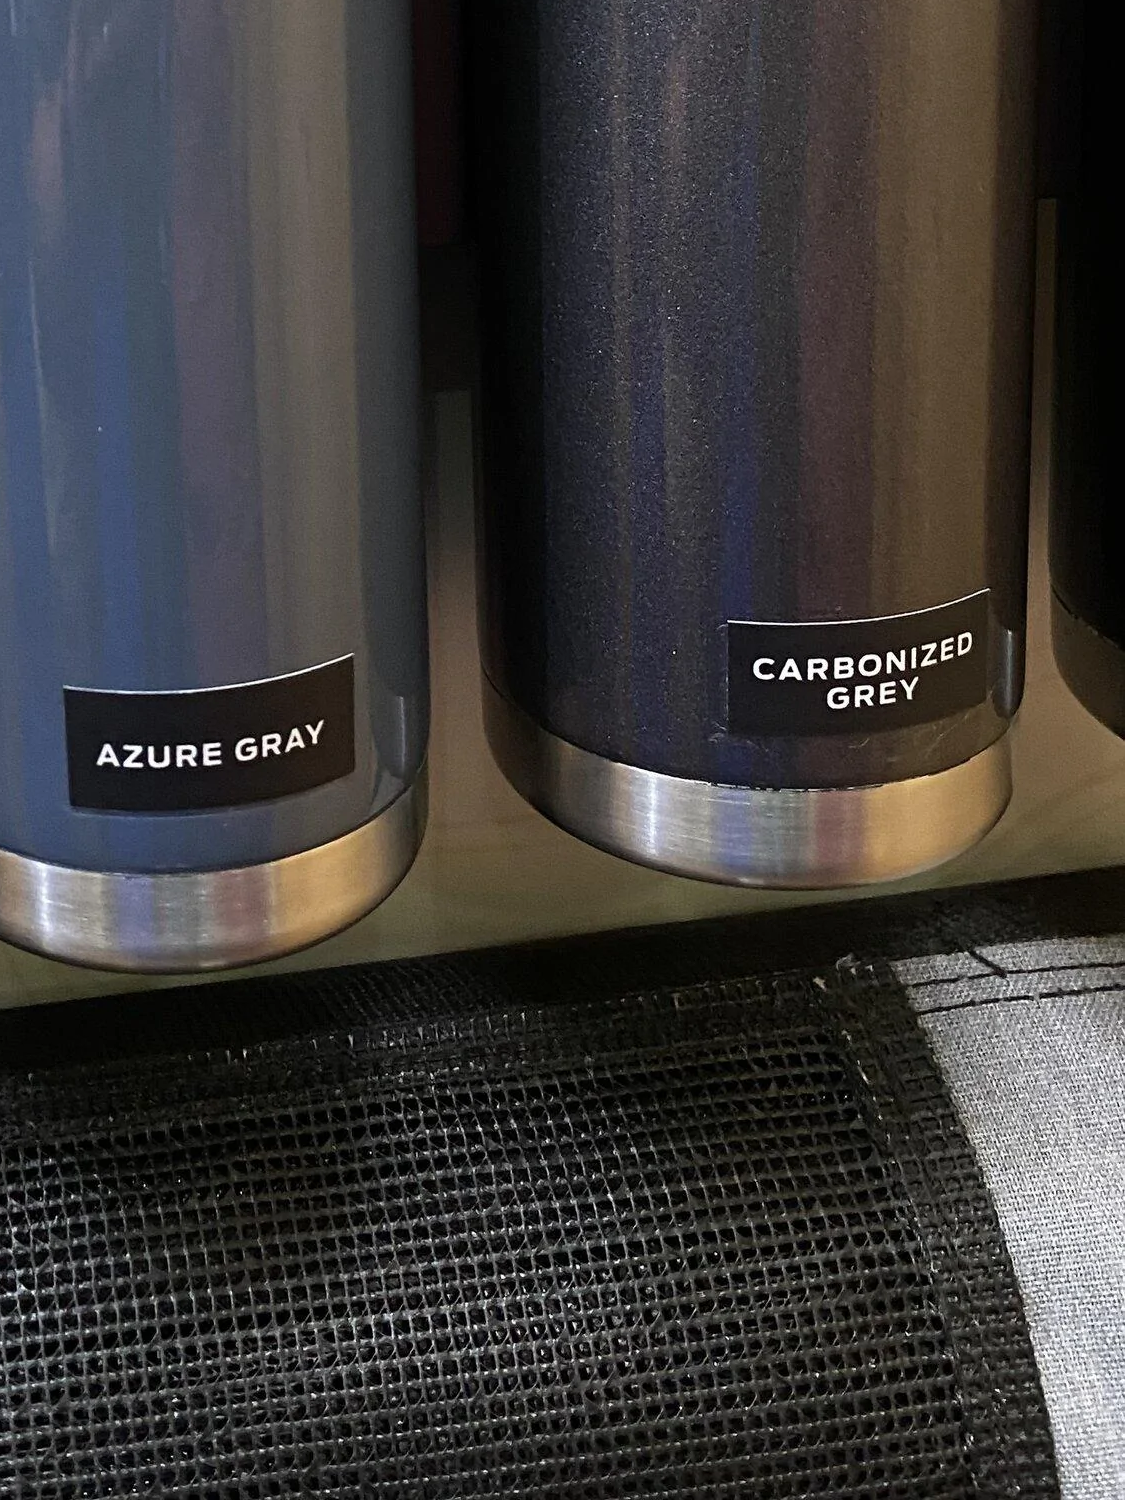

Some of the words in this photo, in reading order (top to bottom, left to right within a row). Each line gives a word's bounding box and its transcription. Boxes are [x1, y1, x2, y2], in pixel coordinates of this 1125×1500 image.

[752, 630, 974, 681] CARBONIZED
[826, 676, 920, 710] GREY
[95, 741, 223, 769] AZURE
[234, 718, 325, 762] GRAY
